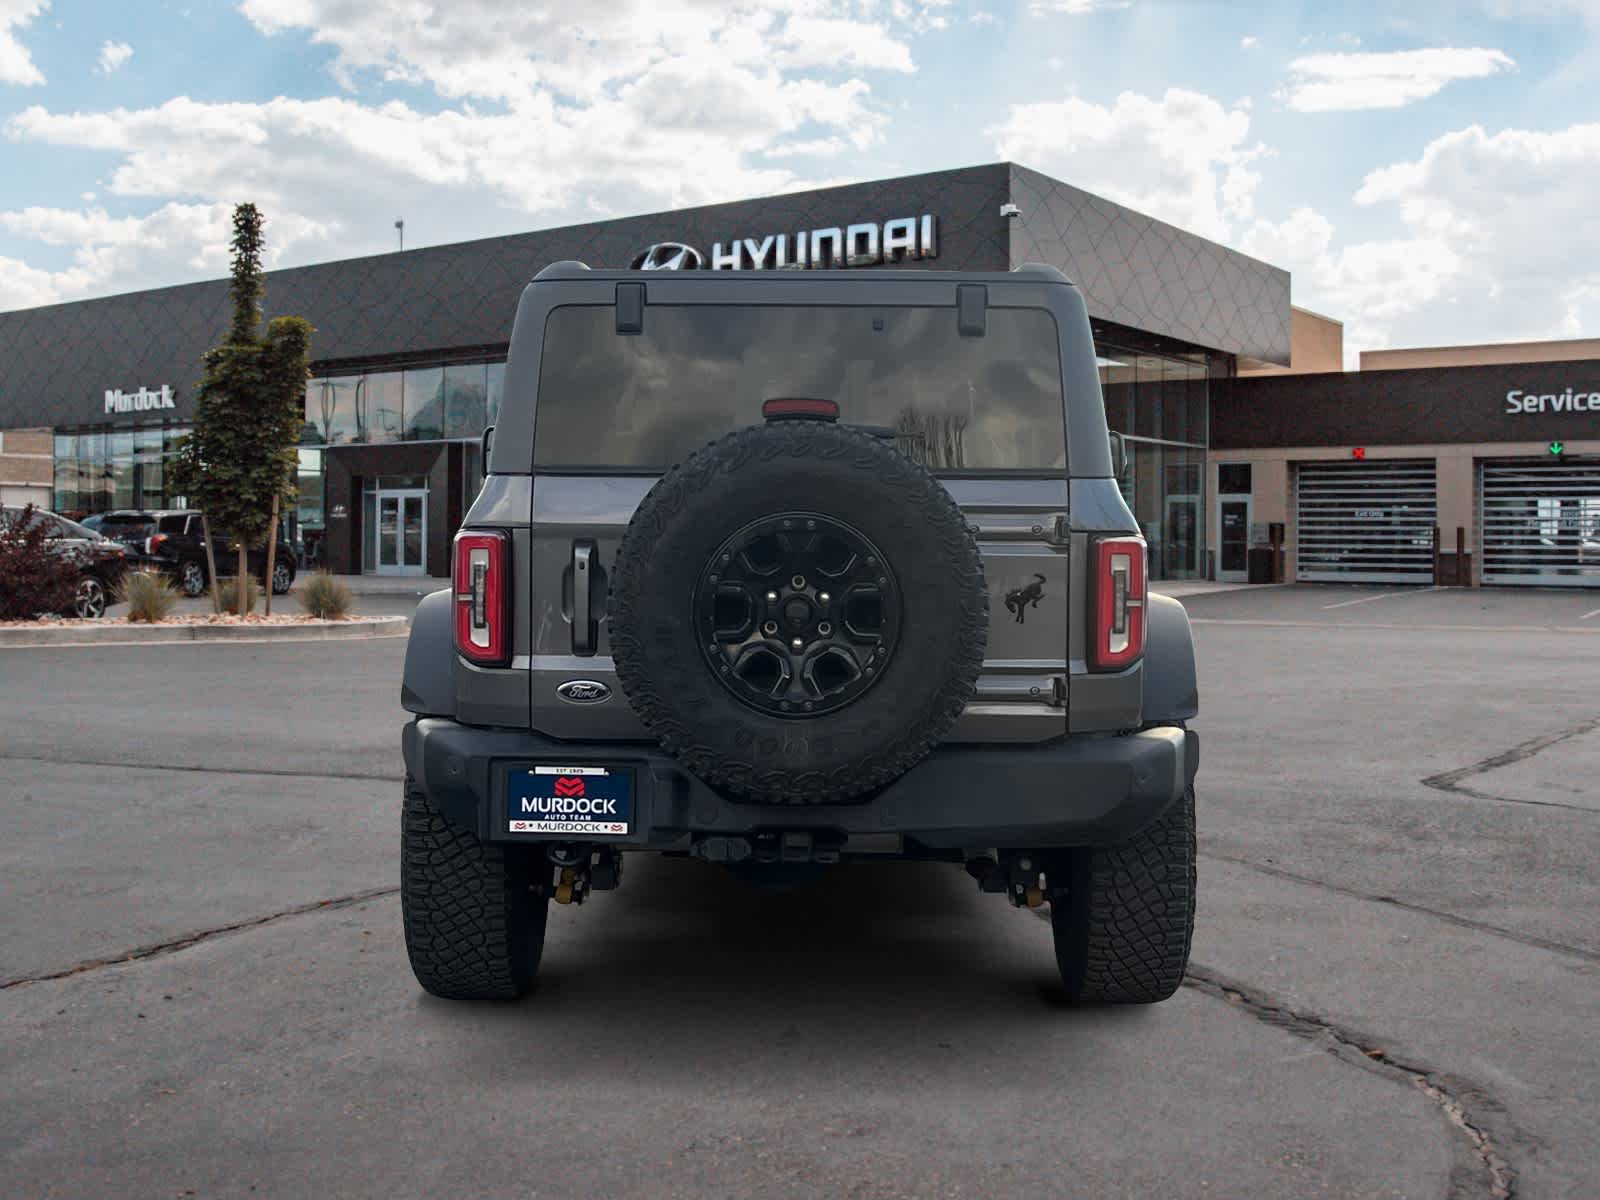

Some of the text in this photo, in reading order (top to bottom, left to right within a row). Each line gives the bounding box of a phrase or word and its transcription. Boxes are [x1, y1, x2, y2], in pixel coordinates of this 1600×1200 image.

[712, 214, 937, 270] HYUNDAI
[104, 384, 176, 414] Murdock
[1505, 387, 1600, 414] Service
[569, 684, 599, 698] Ford
[521, 797, 617, 814] MURDOCK
[537, 822, 601, 832] MURDOCK
